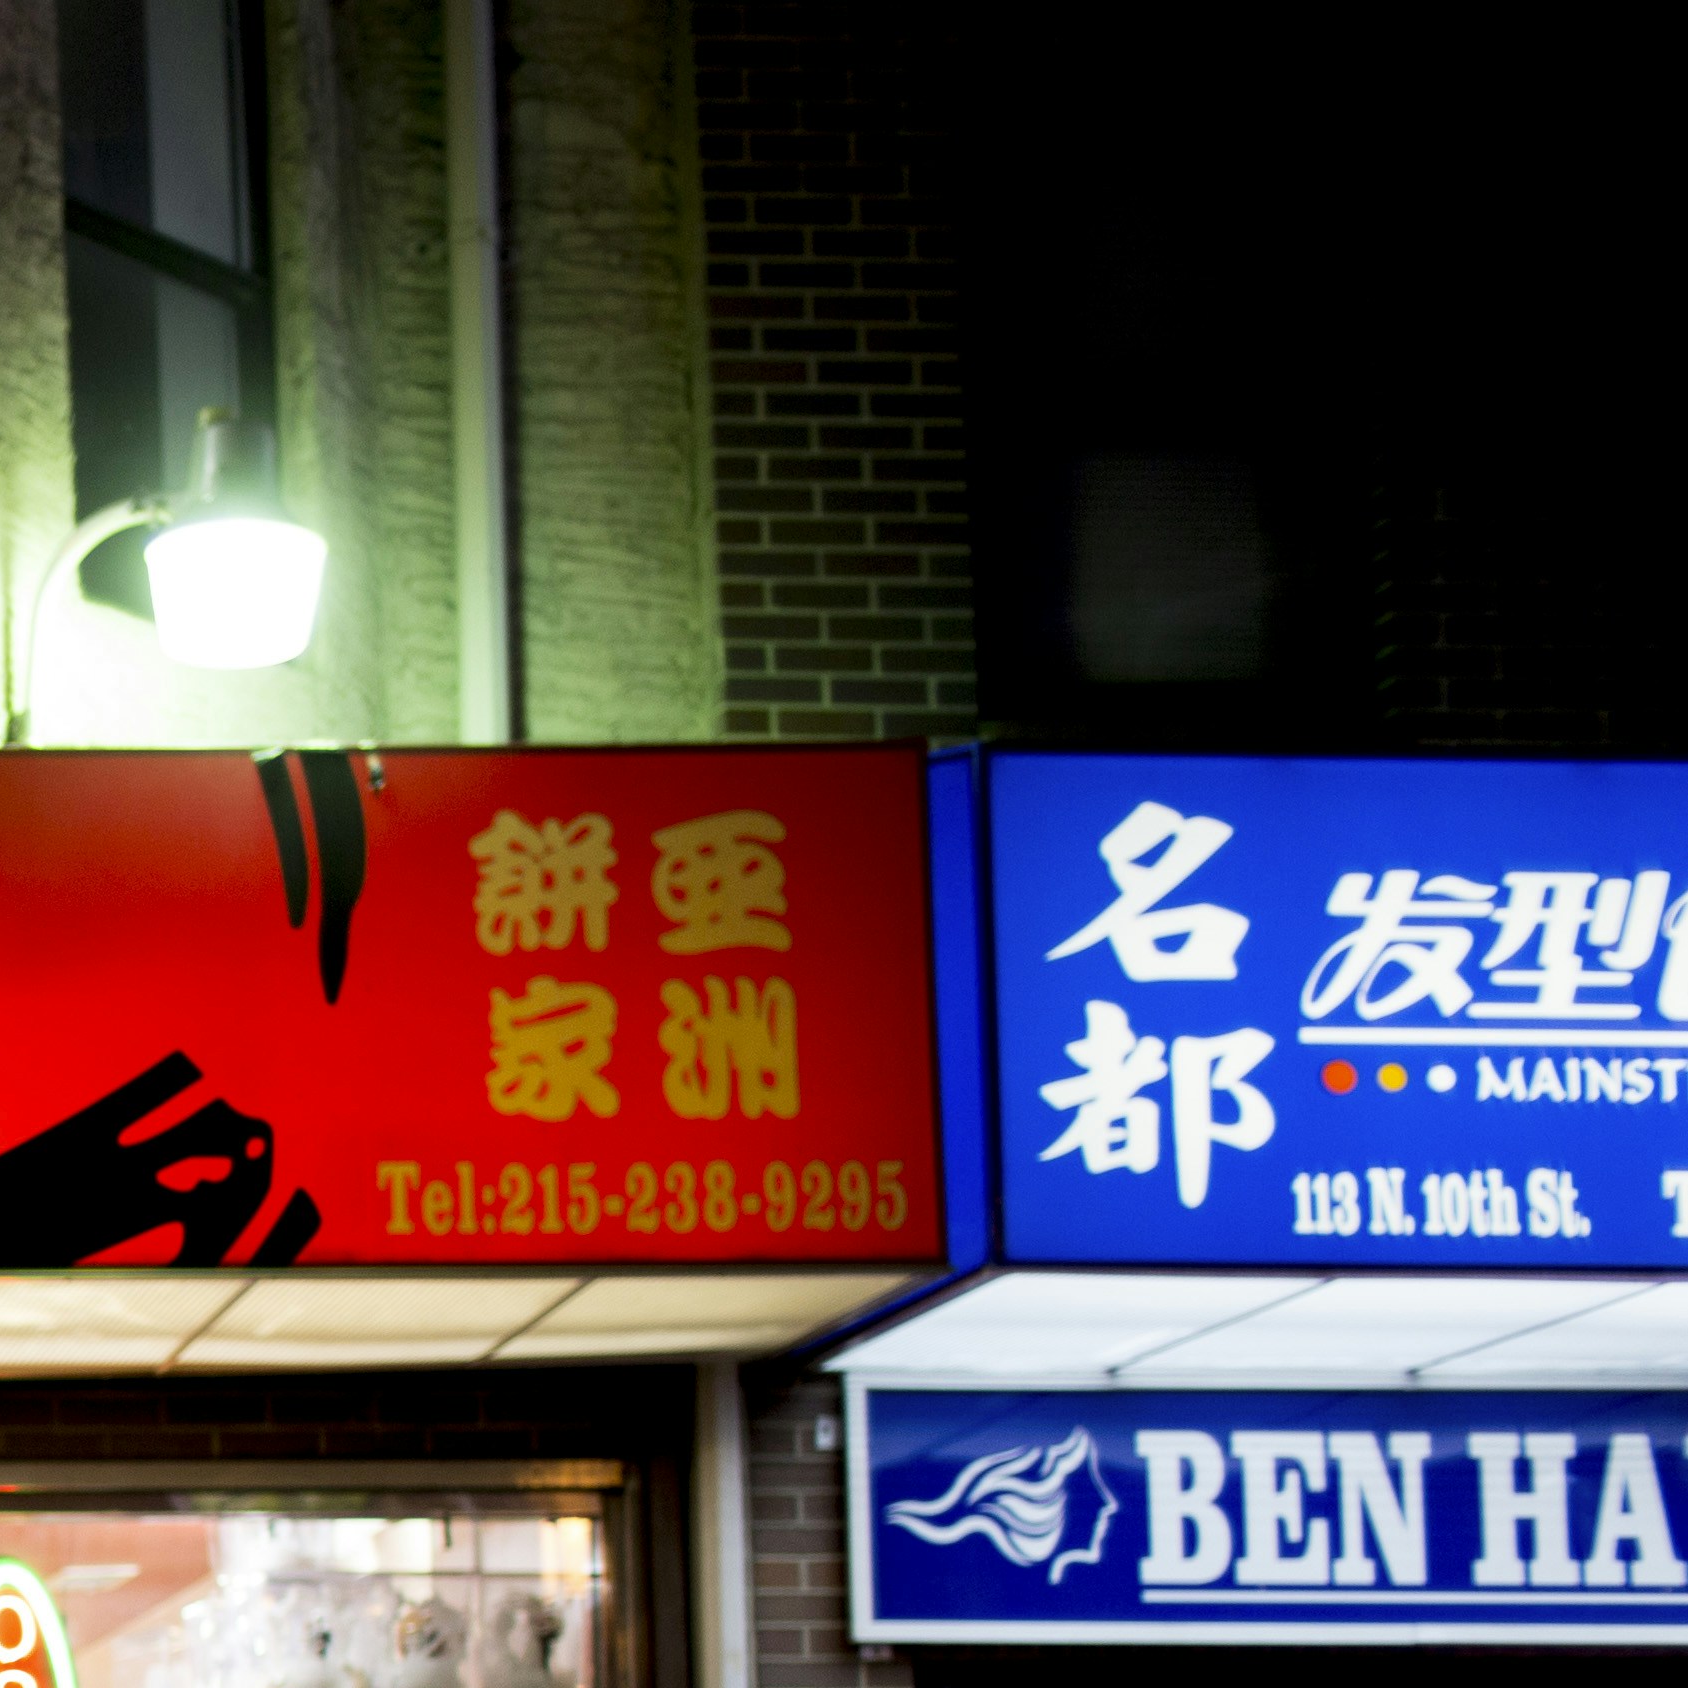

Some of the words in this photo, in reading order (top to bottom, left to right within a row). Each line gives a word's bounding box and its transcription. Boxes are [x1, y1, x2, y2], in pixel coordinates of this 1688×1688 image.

[1301, 868, 1688, 1024] 发型
[1039, 800, 1276, 1209] 名都
[1476, 1056, 1688, 1104] MAINST
[377, 1160, 908, 1236] Tel:215-238-9295
[1293, 1172, 1360, 1236] 113
[1367, 1169, 1415, 1237] N.
[1423, 1169, 1520, 1237] 10th
[1527, 1168, 1591, 1238] St.
[1136, 1430, 1431, 1586] BEN
[1468, 1431, 1688, 1588] HA
